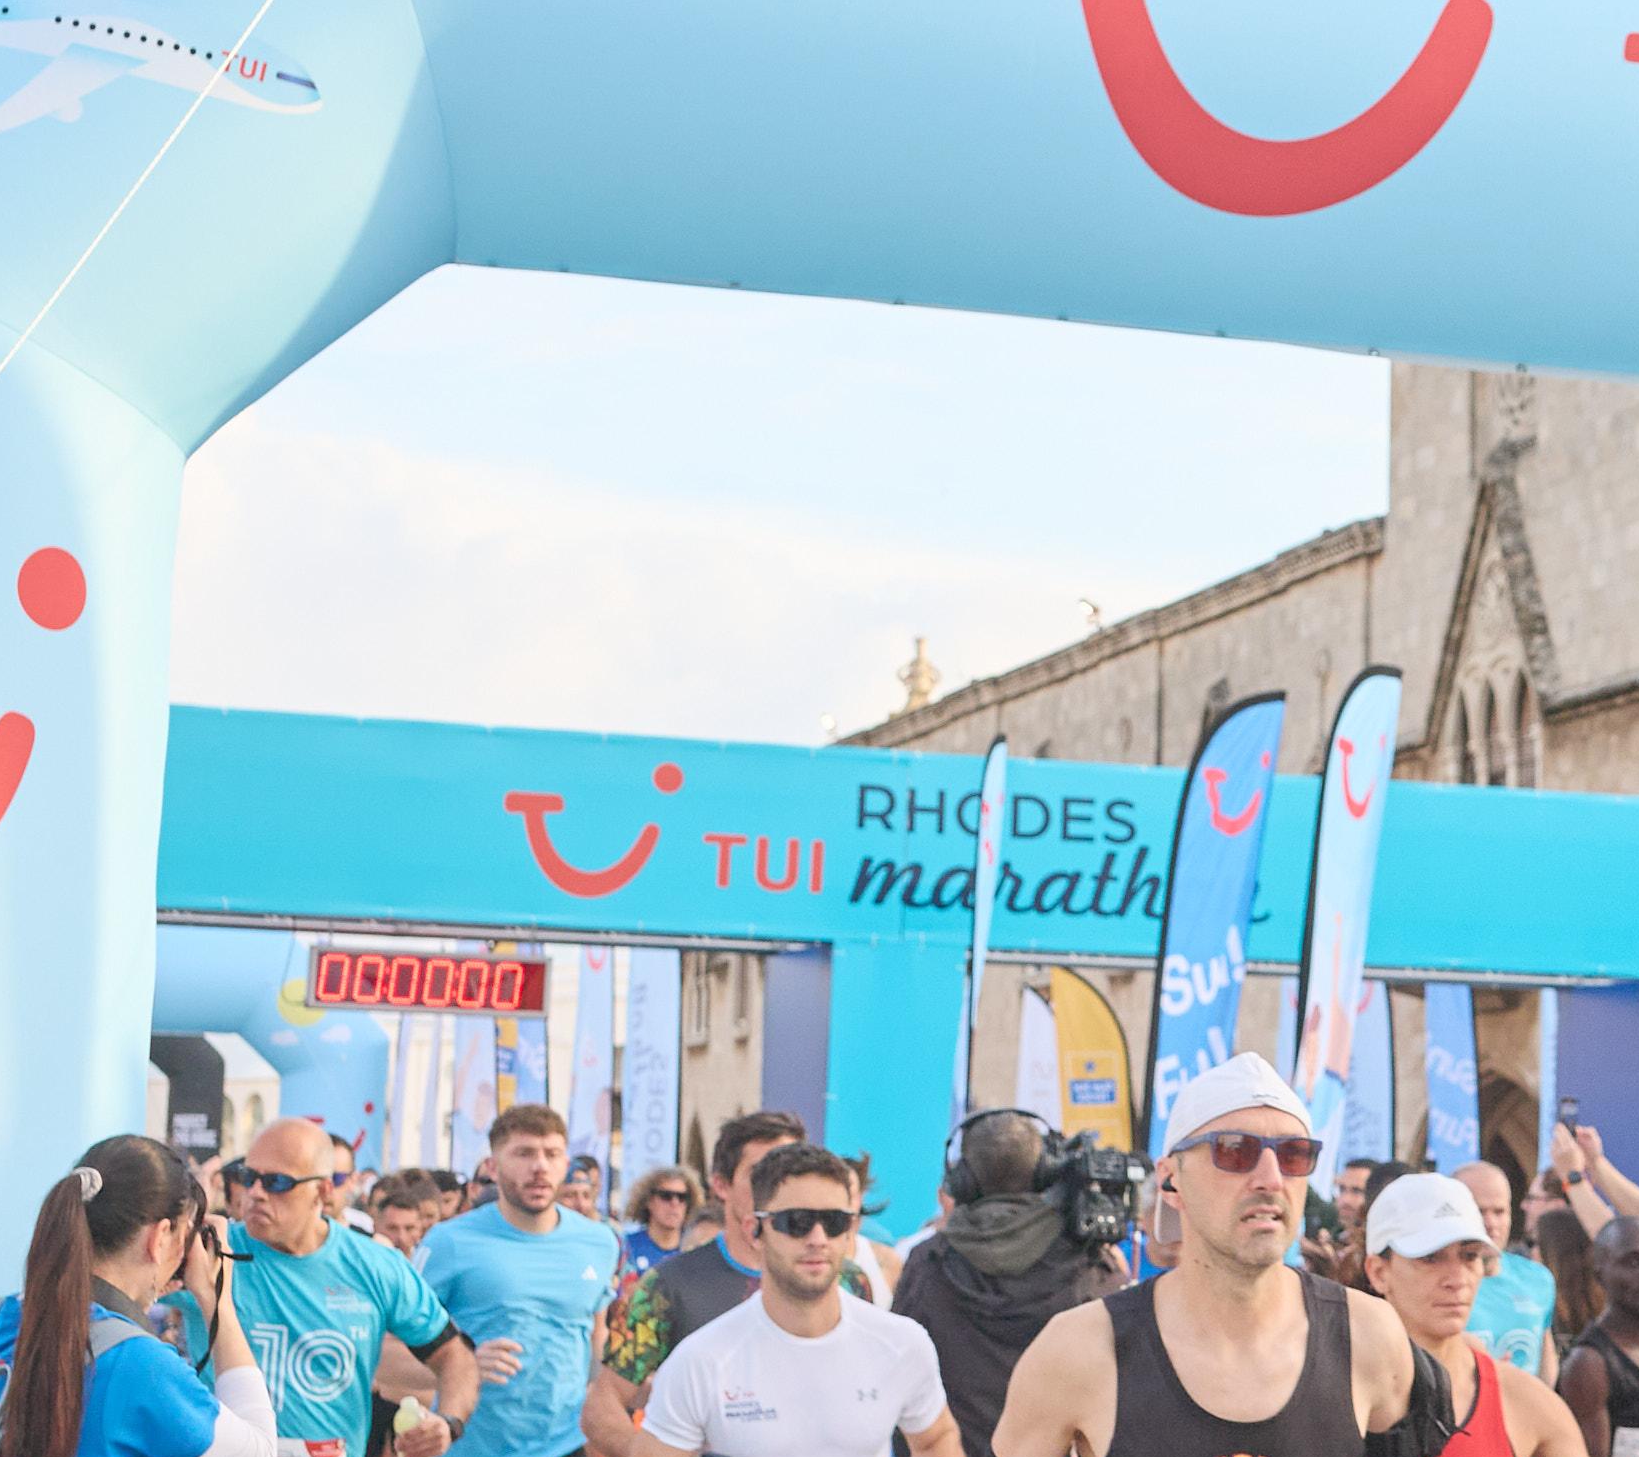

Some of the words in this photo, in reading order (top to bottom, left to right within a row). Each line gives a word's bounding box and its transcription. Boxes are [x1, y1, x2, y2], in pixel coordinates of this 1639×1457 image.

[221, 50, 267, 83] TUI
[703, 833, 824, 893] TUI
[850, 847, 1270, 924] marath
